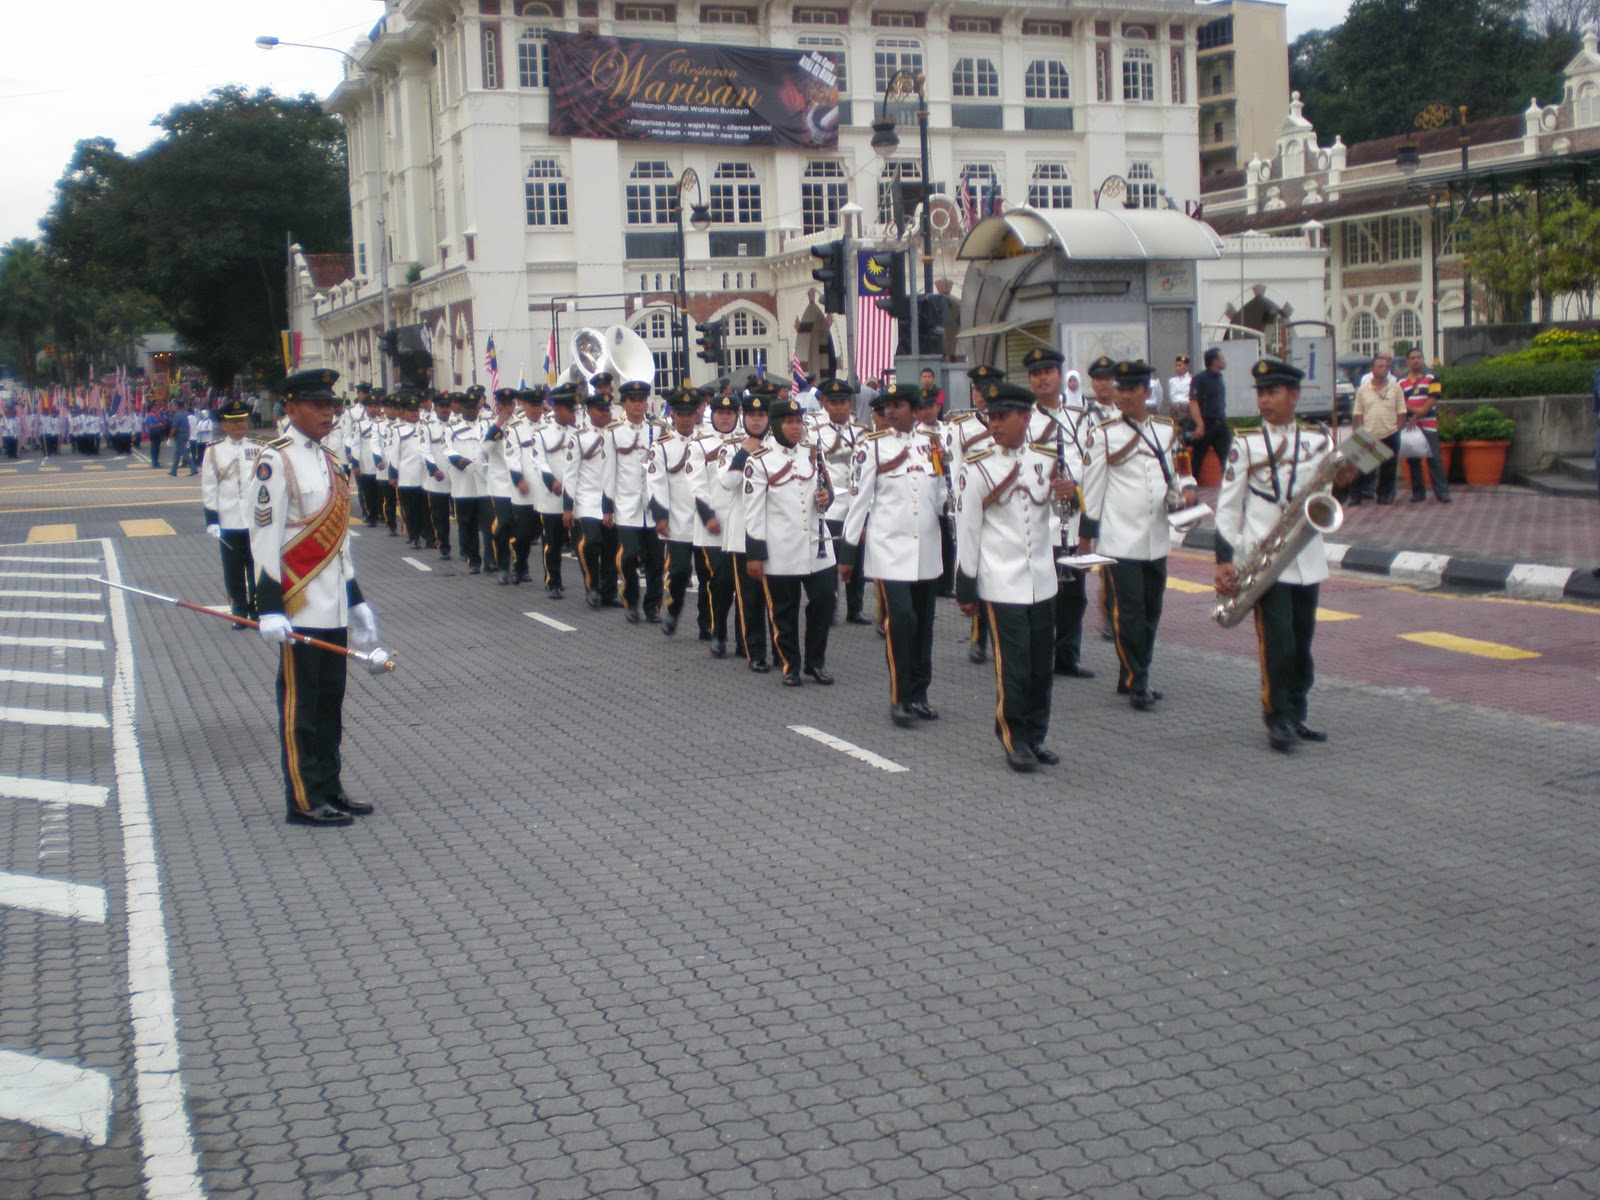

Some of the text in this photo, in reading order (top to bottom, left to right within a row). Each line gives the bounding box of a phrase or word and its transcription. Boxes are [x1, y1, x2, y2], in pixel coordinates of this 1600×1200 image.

[591, 48, 763, 107] Warisan
[670, 58, 739, 79] Restoran
[631, 101, 749, 116] Makanan Tradisi Warisan Budaya
